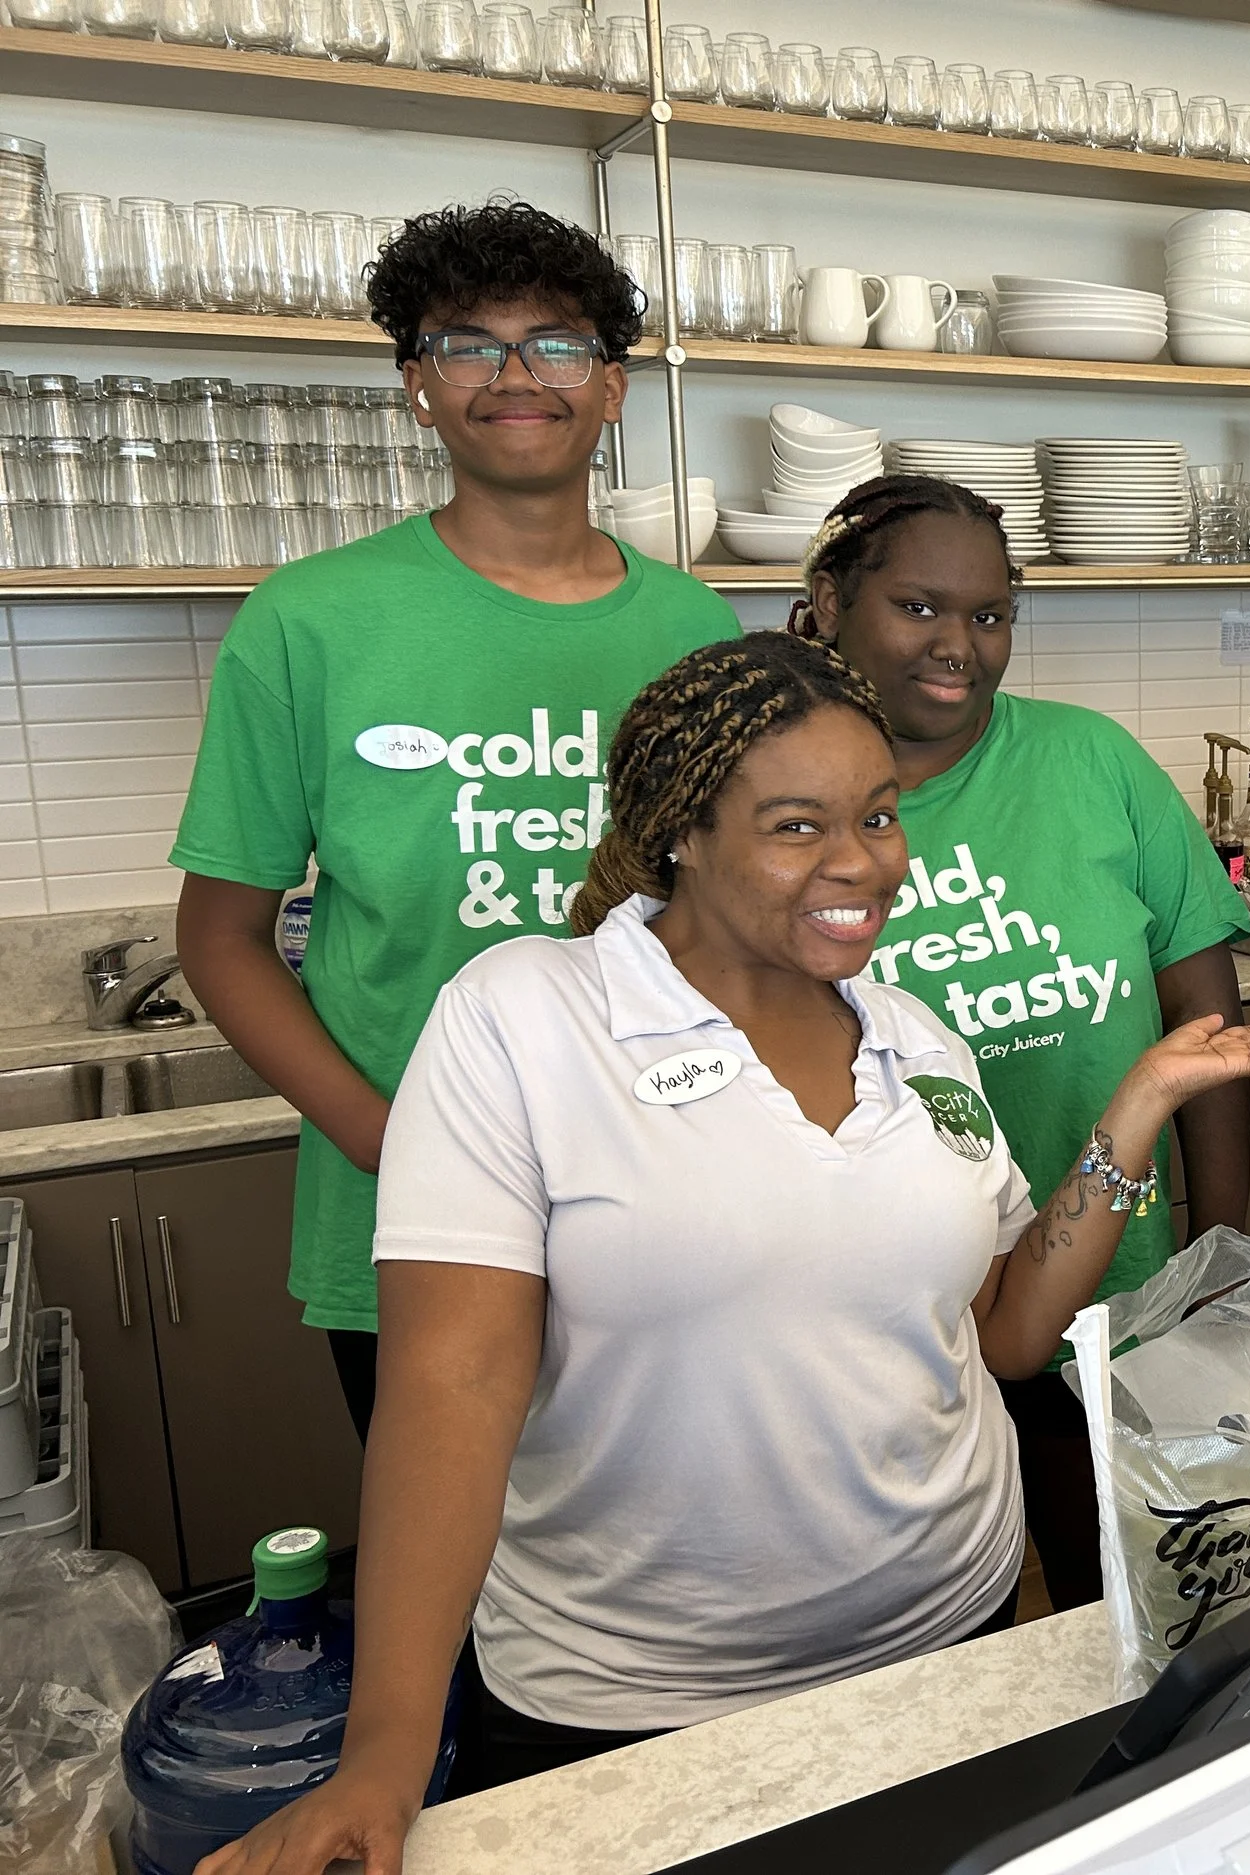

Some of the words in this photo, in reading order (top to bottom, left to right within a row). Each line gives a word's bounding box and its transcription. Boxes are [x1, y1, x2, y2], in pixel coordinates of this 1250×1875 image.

[458, 859, 524, 929] &
[944, 953, 1131, 1037] tasty.
[979, 1042, 1010, 1063] City
[1012, 1031, 1065, 1052] Juicery
[649, 1062, 706, 1095] Kayla
[931, 1091, 972, 1112] City
